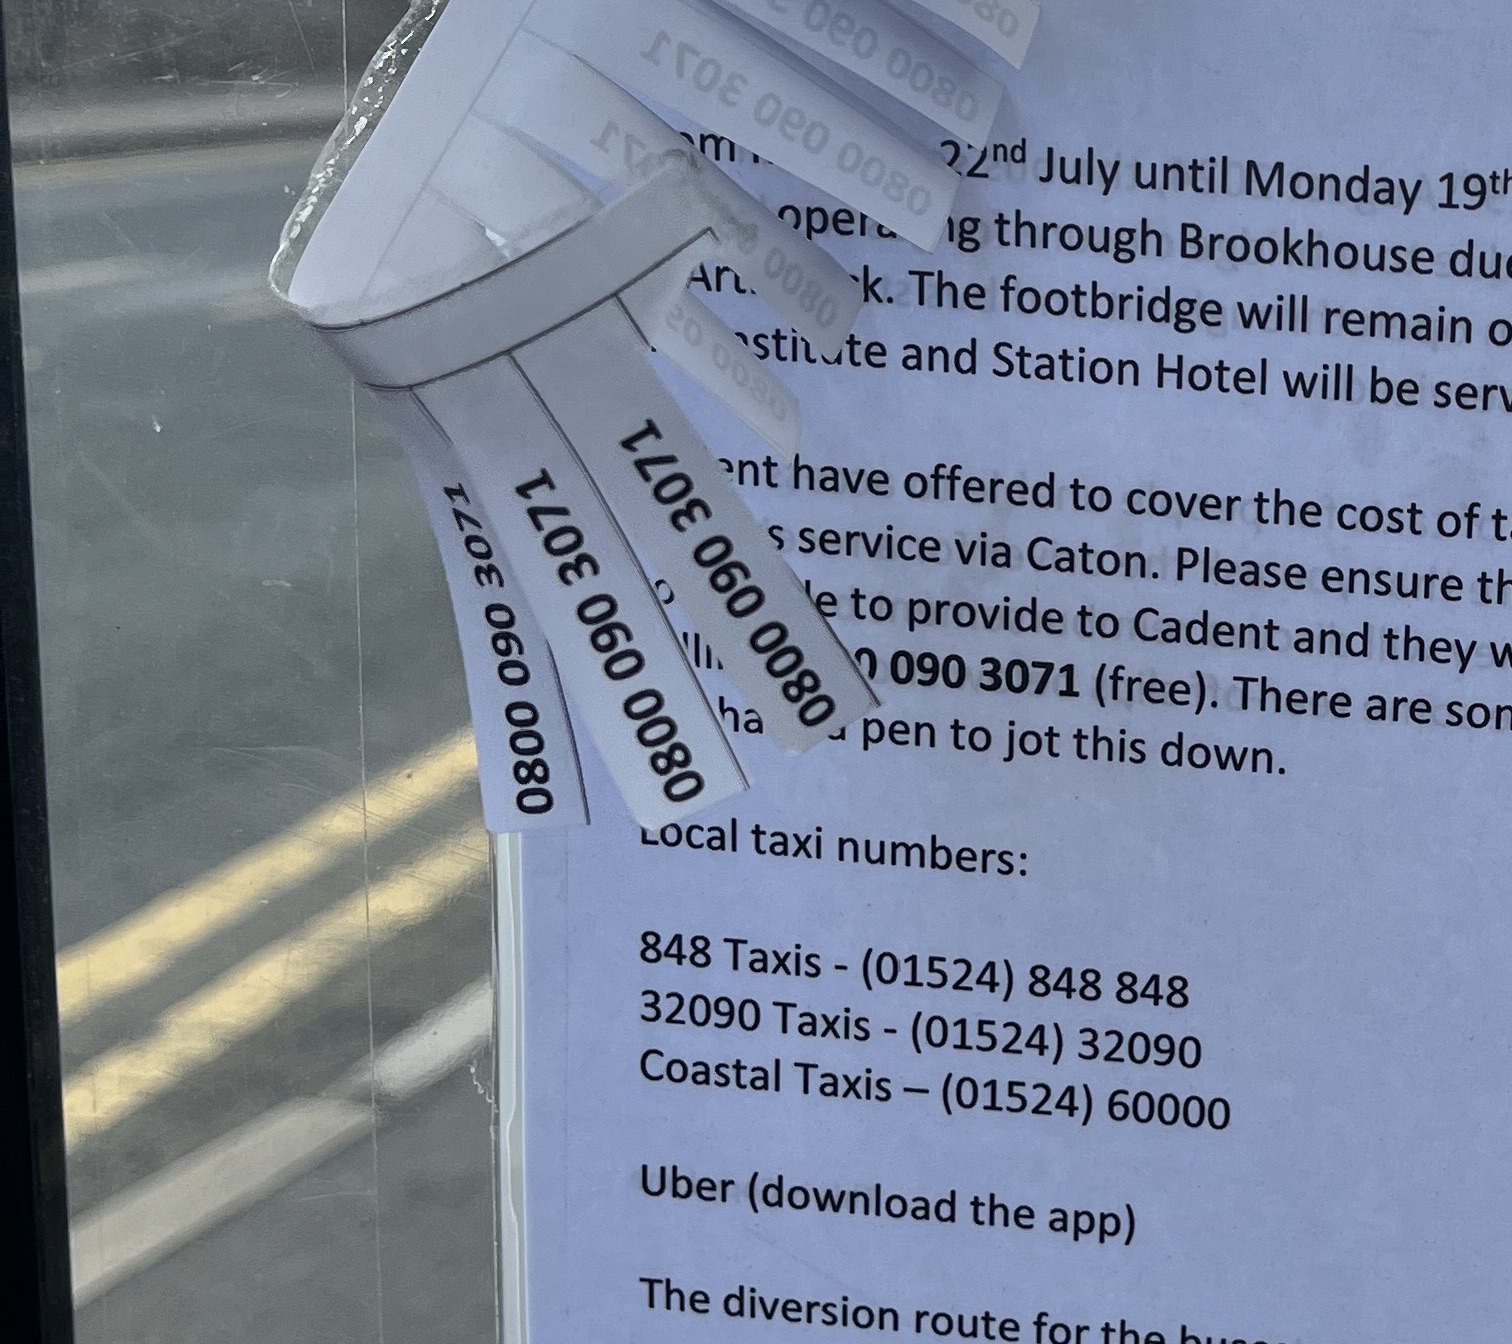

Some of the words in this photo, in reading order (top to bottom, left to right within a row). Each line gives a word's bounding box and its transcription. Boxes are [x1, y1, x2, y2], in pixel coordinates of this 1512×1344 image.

[1039, 147, 1120, 196] July
[1135, 156, 1227, 194] until
[1246, 160, 1422, 215] Monday
[994, 209, 1162, 264] through
[1181, 223, 1434, 274] Brookhouse
[908, 270, 986, 310] The
[1000, 275, 1222, 334] footbridge
[1237, 294, 1307, 332] will
[1325, 306, 1472, 344] remain
[902, 338, 976, 375] and
[993, 342, 1139, 386] Station
[1157, 353, 1267, 395] Hotel
[1283, 363, 1353, 401] will
[1370, 366, 1419, 406] be
[620, 419, 712, 532] 3071
[794, 453, 889, 496] have
[904, 463, 1055, 508] offered
[1069, 478, 1112, 512] to
[1127, 489, 1241, 521] cover
[1254, 488, 1322, 528] the
[1337, 502, 1423, 535] cost
[1437, 502, 1481, 539] of
[516, 468, 599, 586] 3071
[799, 525, 940, 562] service
[955, 532, 1011, 568] via
[1027, 537, 1158, 579] Caton.
[1177, 547, 1306, 590] Please
[1322, 567, 1463, 601] ensure
[694, 536, 765, 618] 090
[577, 594, 645, 680] 090
[851, 588, 893, 621] to
[909, 596, 1063, 634] provide
[1077, 605, 1119, 638] to
[1134, 607, 1280, 651] Cadent
[1294, 622, 1369, 657] and
[1383, 624, 1477, 674] they
[750, 622, 835, 727] 0800
[890, 650, 966, 688] 090
[980, 657, 1079, 697] 3071
[1096, 663, 1217, 715] (free).
[1233, 676, 1352, 718] There
[1366, 695, 1432, 724] are
[623, 689, 704, 802] 0800
[863, 718, 935, 751] pen
[950, 719, 991, 752] to
[1003, 720, 1060, 762] jot
[1073, 725, 1146, 764] this
[1161, 732, 1285, 774] down.
[640, 818, 737, 852] Local
[751, 824, 822, 859] taxi
[839, 834, 1027, 876] numbers:
[640, 931, 711, 968] 848
[723, 938, 821, 978] Taxis
[863, 948, 1013, 1002] (01524)
[1029, 964, 1102, 1001] 848
[1116, 971, 1189, 1008] 848
[641, 990, 760, 1031] 32090
[773, 1001, 870, 1041] Taxis
[912, 1011, 1063, 1065] (01524)
[1078, 1028, 1201, 1068] 32090
[640, 1049, 780, 1092] Coastal
[794, 1062, 891, 1102] Taxis
[942, 1073, 1092, 1126] (01524)
[1108, 1089, 1230, 1130] 60000
[642, 1164, 735, 1203] Uber
[749, 1172, 956, 1223] (download
[970, 1193, 1035, 1230] the
[1049, 1204, 1135, 1245] app)
[639, 1277, 710, 1314] The
[723, 1285, 899, 1331] diversion
[915, 1310, 1020, 1342] route
